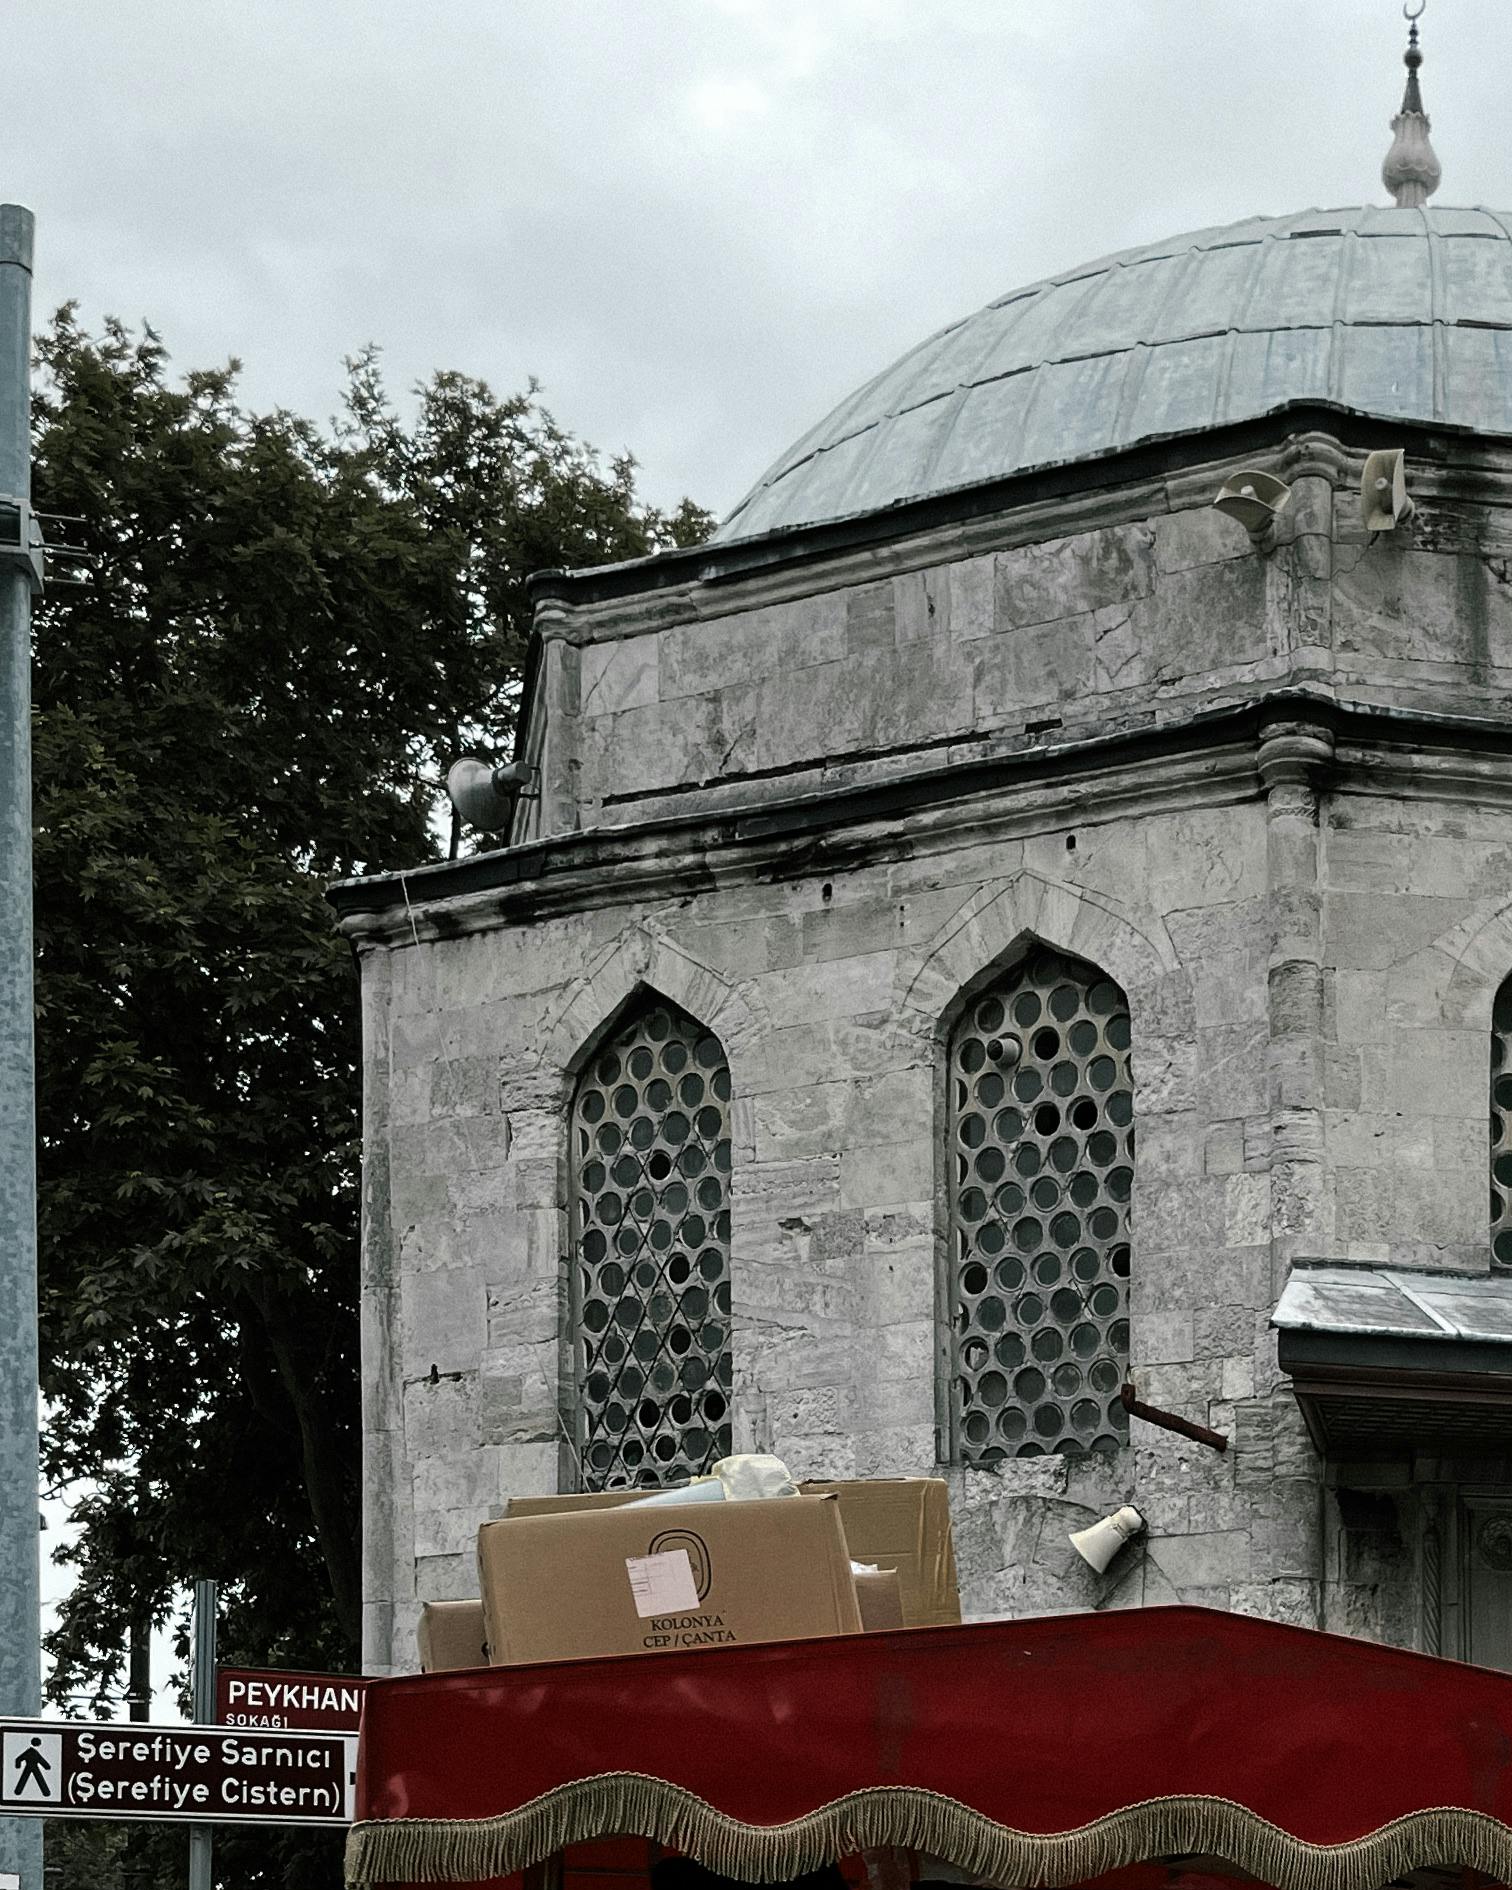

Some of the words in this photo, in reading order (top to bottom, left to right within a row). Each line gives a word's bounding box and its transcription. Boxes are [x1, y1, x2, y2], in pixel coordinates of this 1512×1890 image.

[651, 1615, 724, 1631] KOLONYA
[643, 1635, 671, 1648] CEP
[682, 1630, 736, 1647] ÇANTA
[229, 1680, 366, 1713] PEYKHAN
[226, 1713, 288, 1729] SOKAĞI
[77, 1733, 211, 1769] Şerefiye
[221, 1739, 330, 1768] Sarnıcı
[68, 1772, 210, 1809] (Şerefiye
[221, 1778, 340, 1813] Cistern)
